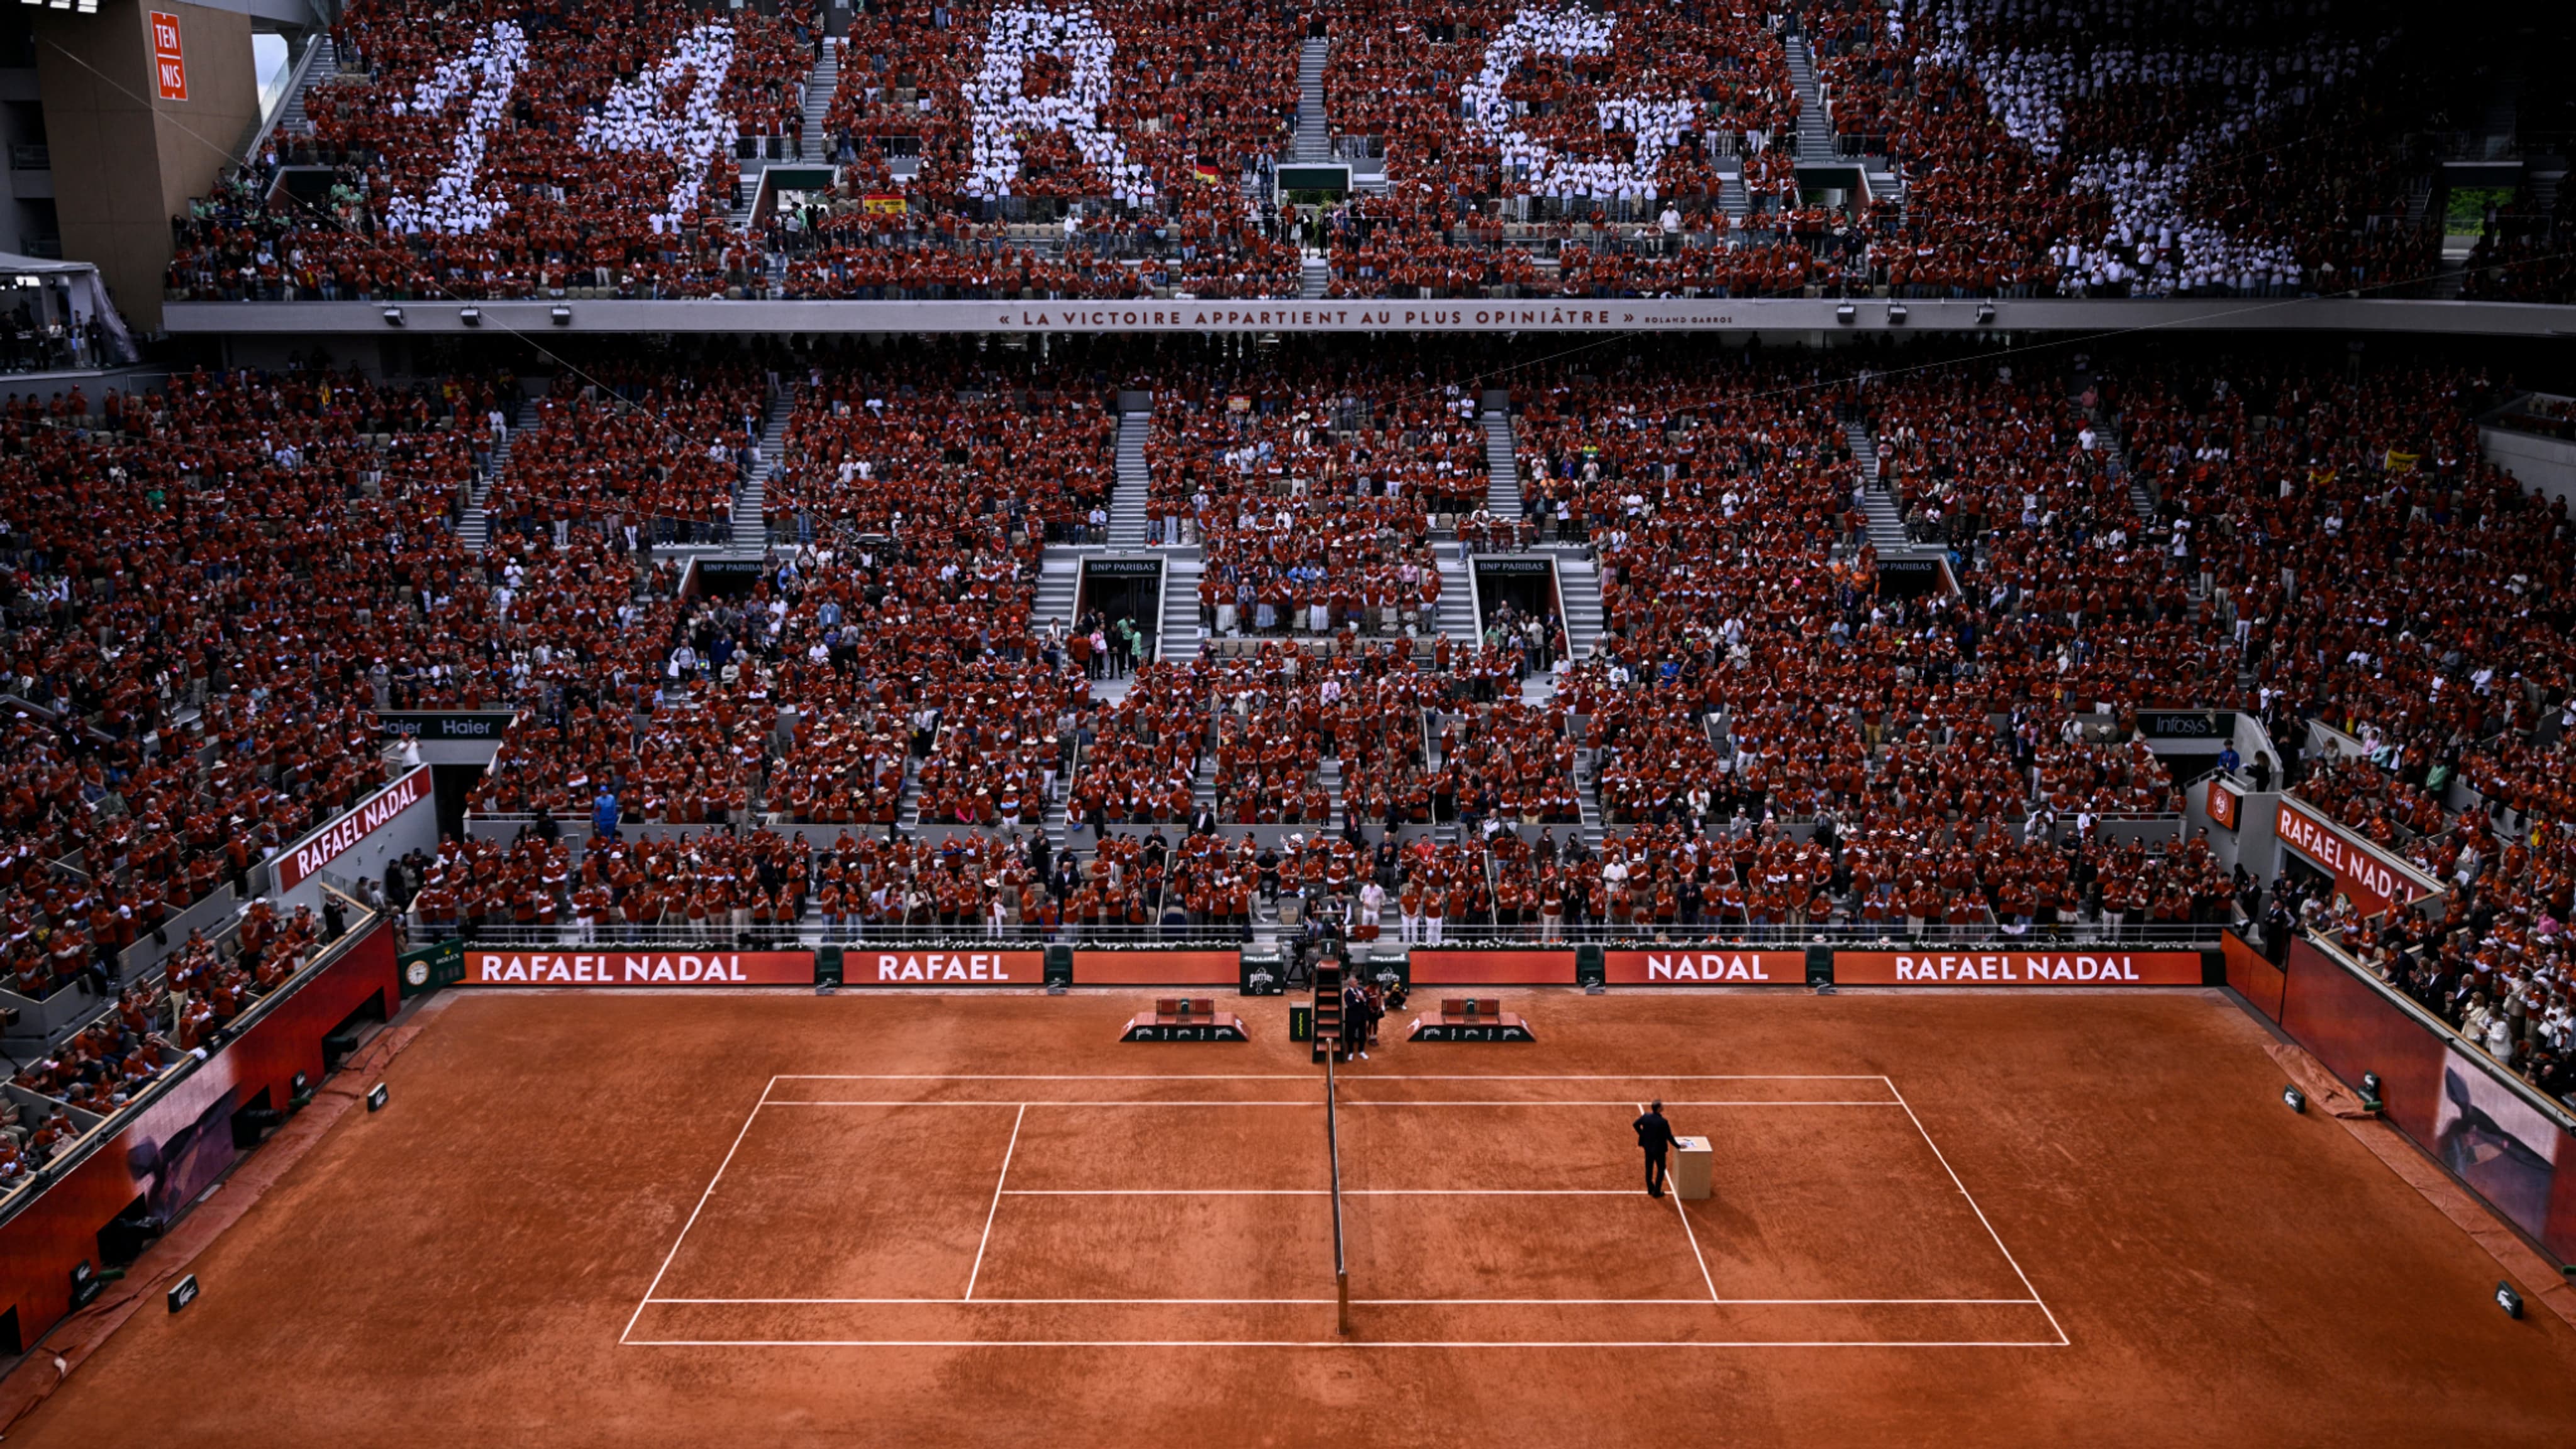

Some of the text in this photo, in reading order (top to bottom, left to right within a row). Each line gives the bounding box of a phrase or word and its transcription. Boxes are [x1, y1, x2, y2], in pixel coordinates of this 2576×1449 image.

[155, 24, 177, 49] TEN
[161, 64, 181, 89] NIS
[1023, 311, 1050, 325] LA
[1063, 311, 1180, 325] VICTOIRE
[1195, 311, 1348, 325] APPARTIENT
[1361, 311, 1390, 325] AU
[1406, 311, 1462, 325] PLUS
[1476, 306, 1609, 325] OPINIÂTRE
[704, 563, 762, 572] BNP PARIBA
[1091, 563, 1156, 572] BNP PARIBAS
[1480, 562, 1545, 571] BNP PARIBAS
[1890, 562, 1932, 571] PARIBAS
[441, 719, 491, 735] Haier
[2156, 716, 2207, 735] Infosys
[297, 778, 418, 879] RAFAEL NADAL
[2280, 809, 2345, 872] RAFAEL
[481, 955, 614, 982] RAFAEL
[625, 955, 747, 982] NADAL
[878, 955, 1009, 980] RAFAEL
[1648, 955, 1768, 980] NADAL
[1895, 956, 2140, 980] RAFAEL NADAL
